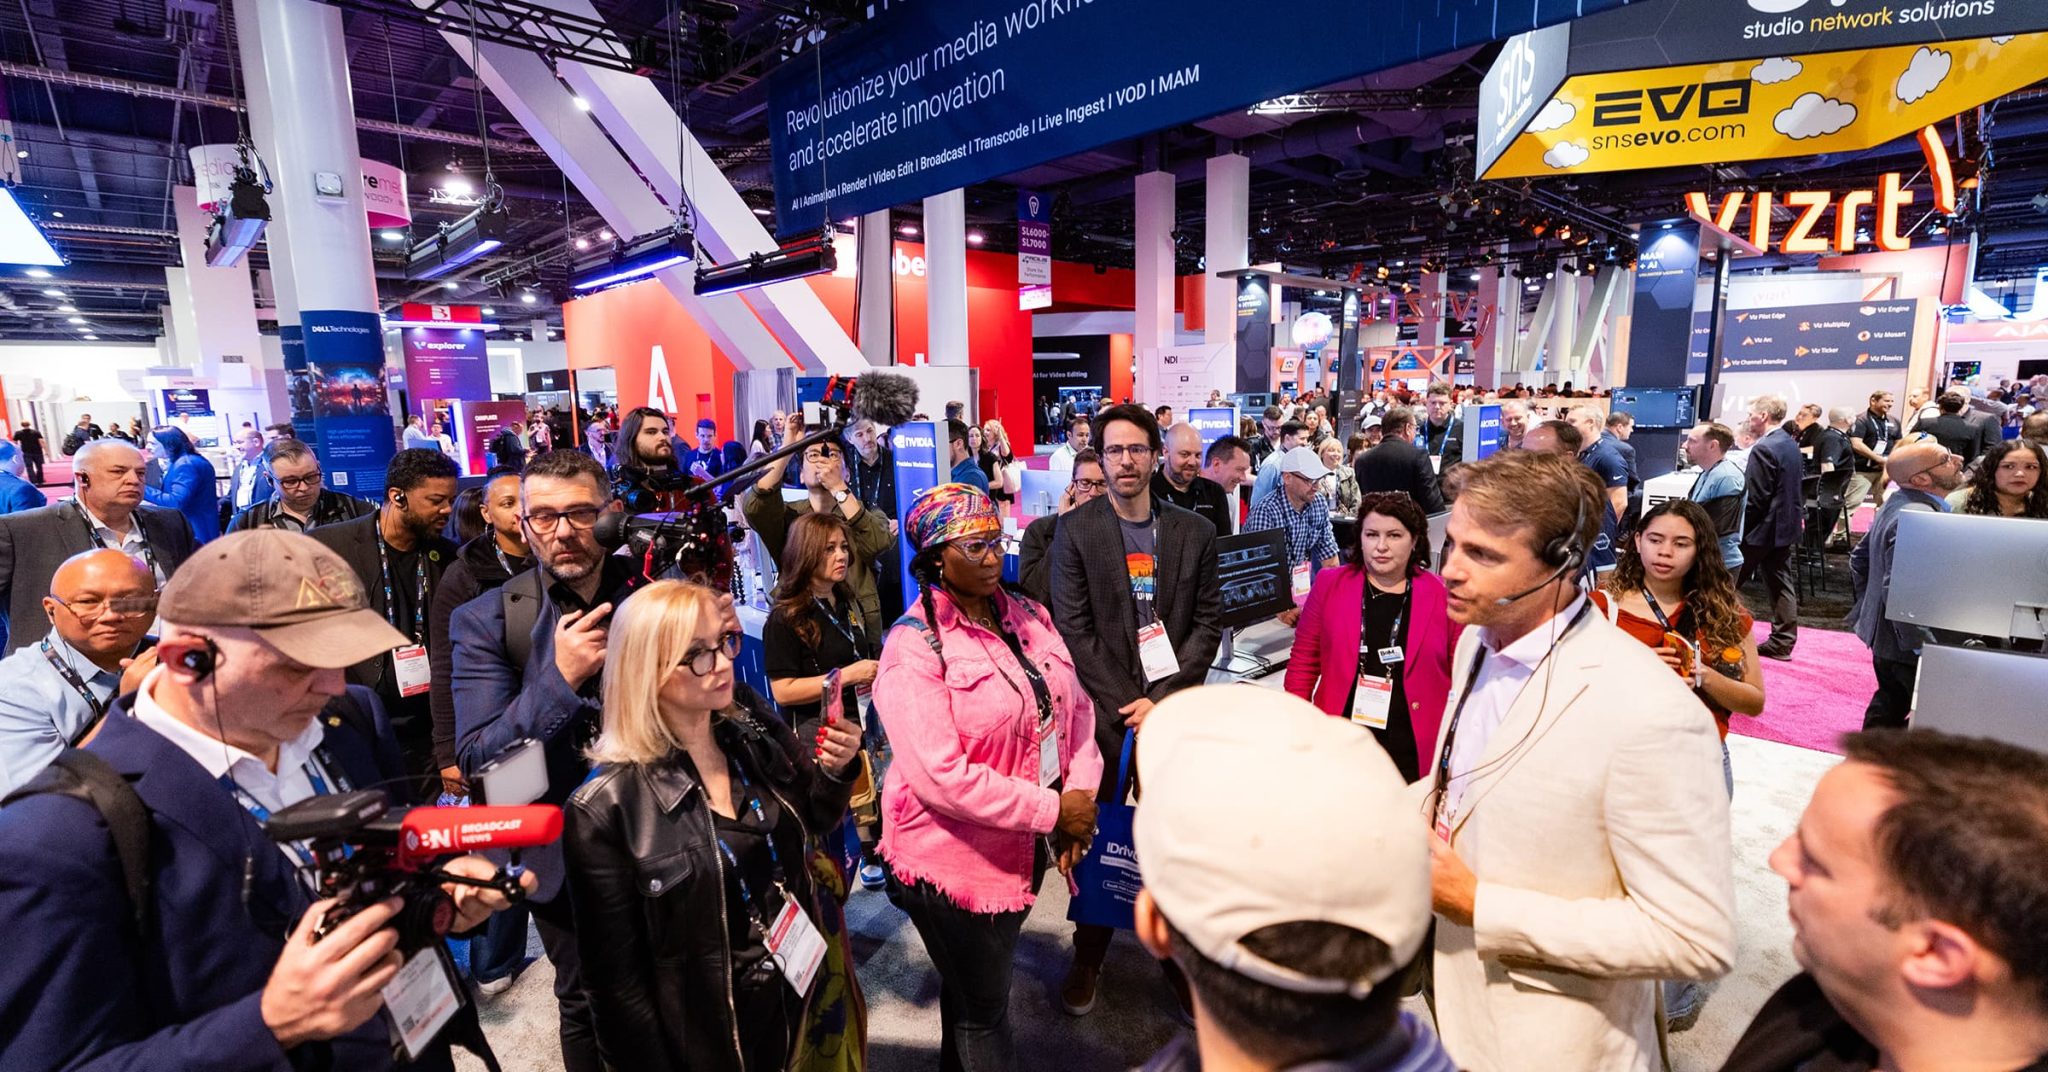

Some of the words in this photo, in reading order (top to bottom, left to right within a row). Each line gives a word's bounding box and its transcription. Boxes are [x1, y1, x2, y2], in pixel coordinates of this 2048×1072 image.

[1743, 17, 1804, 39] studio
[1810, 7, 1893, 32] network
[1898, 0, 1995, 24] solutions
[787, 75, 884, 135] Revoutionize
[888, 53, 928, 98] your
[934, 20, 997, 71] media
[1004, 0, 1094, 38] work
[1497, 30, 1536, 128] sns
[1593, 79, 1752, 127] EVO
[789, 139, 814, 171] and
[817, 112, 897, 160] accelerate
[902, 68, 1005, 129] innovation
[791, 199, 799, 210] AI
[803, 186, 837, 206] Animation
[841, 177, 867, 195] Render
[873, 168, 896, 184] Video
[897, 161, 914, 177] Edit
[920, 143, 967, 170] Broadcast
[974, 123, 1029, 153] Transcode
[1038, 113, 1063, 132] Live
[1065, 97, 1105, 124] Ingest
[1115, 82, 1146, 107] VOD
[1159, 64, 1200, 94] MAM
[1592, 123, 1745, 150] snsevo.com
[1022, 238, 1047, 249] SL7000
[1640, 251, 1665, 261] MAM
[1647, 261, 1658, 270] AI
[1771, 312, 1786, 320] Edge
[427, 342, 466, 351] explorer
[1164, 356, 1178, 364] NDI
[1066, 371, 1088, 379] Editing
[461, 819, 523, 834] BROADCAST
[461, 833, 493, 844] NEWS
